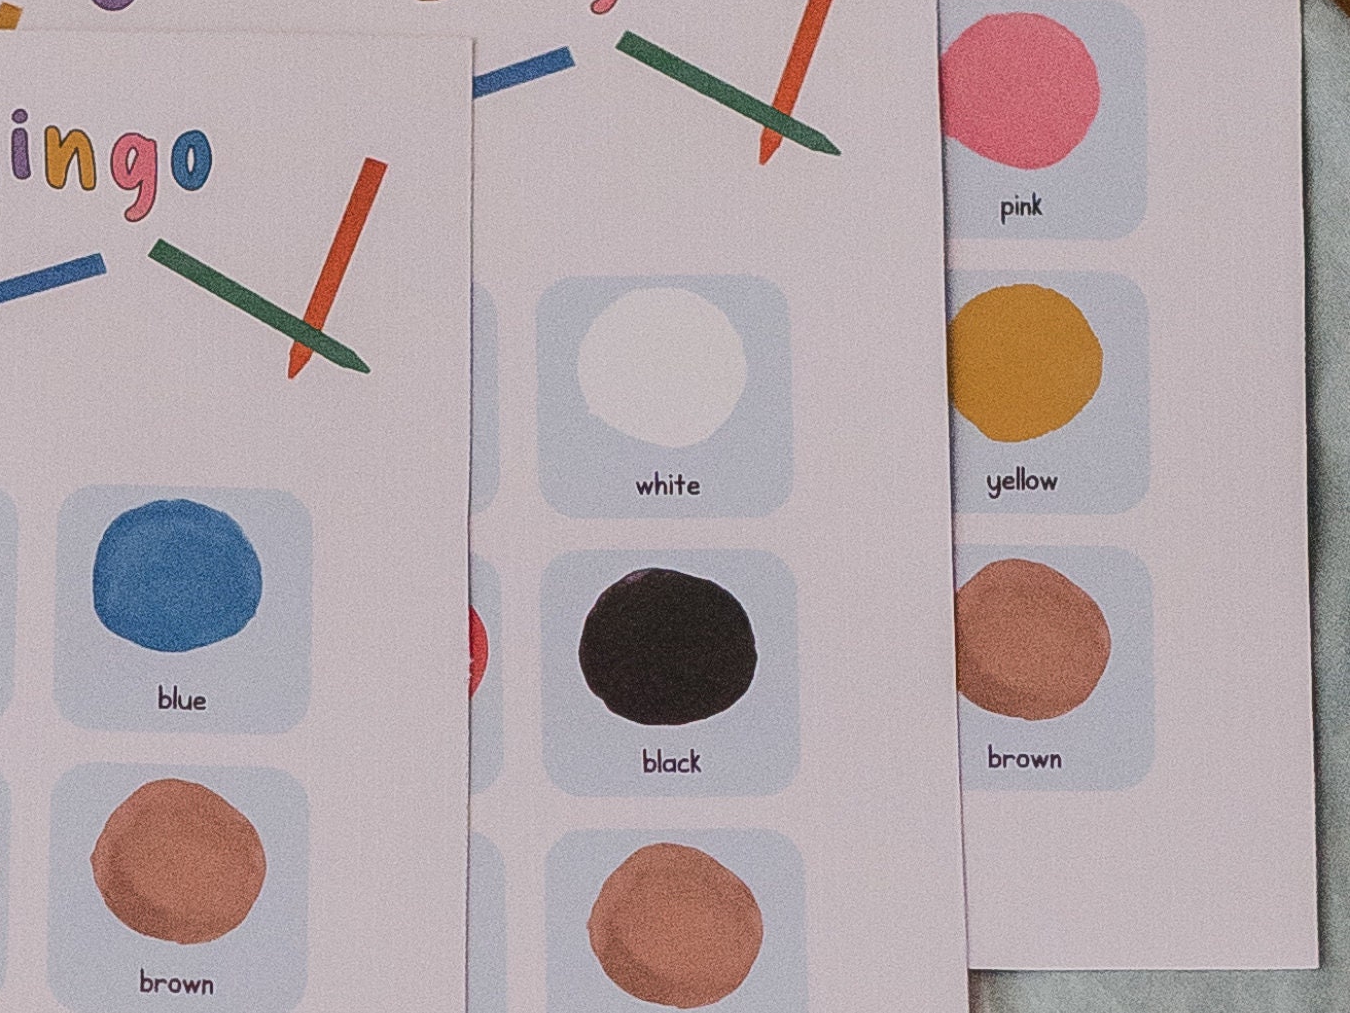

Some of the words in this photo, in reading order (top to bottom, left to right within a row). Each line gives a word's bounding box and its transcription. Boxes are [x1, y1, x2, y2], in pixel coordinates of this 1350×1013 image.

[1001, 193, 1042, 224] pink
[636, 472, 700, 495] white
[987, 467, 1057, 499] yellow
[158, 685, 206, 710] blue
[643, 749, 701, 773] black
[988, 745, 1062, 769] brown
[140, 969, 214, 994] brown
